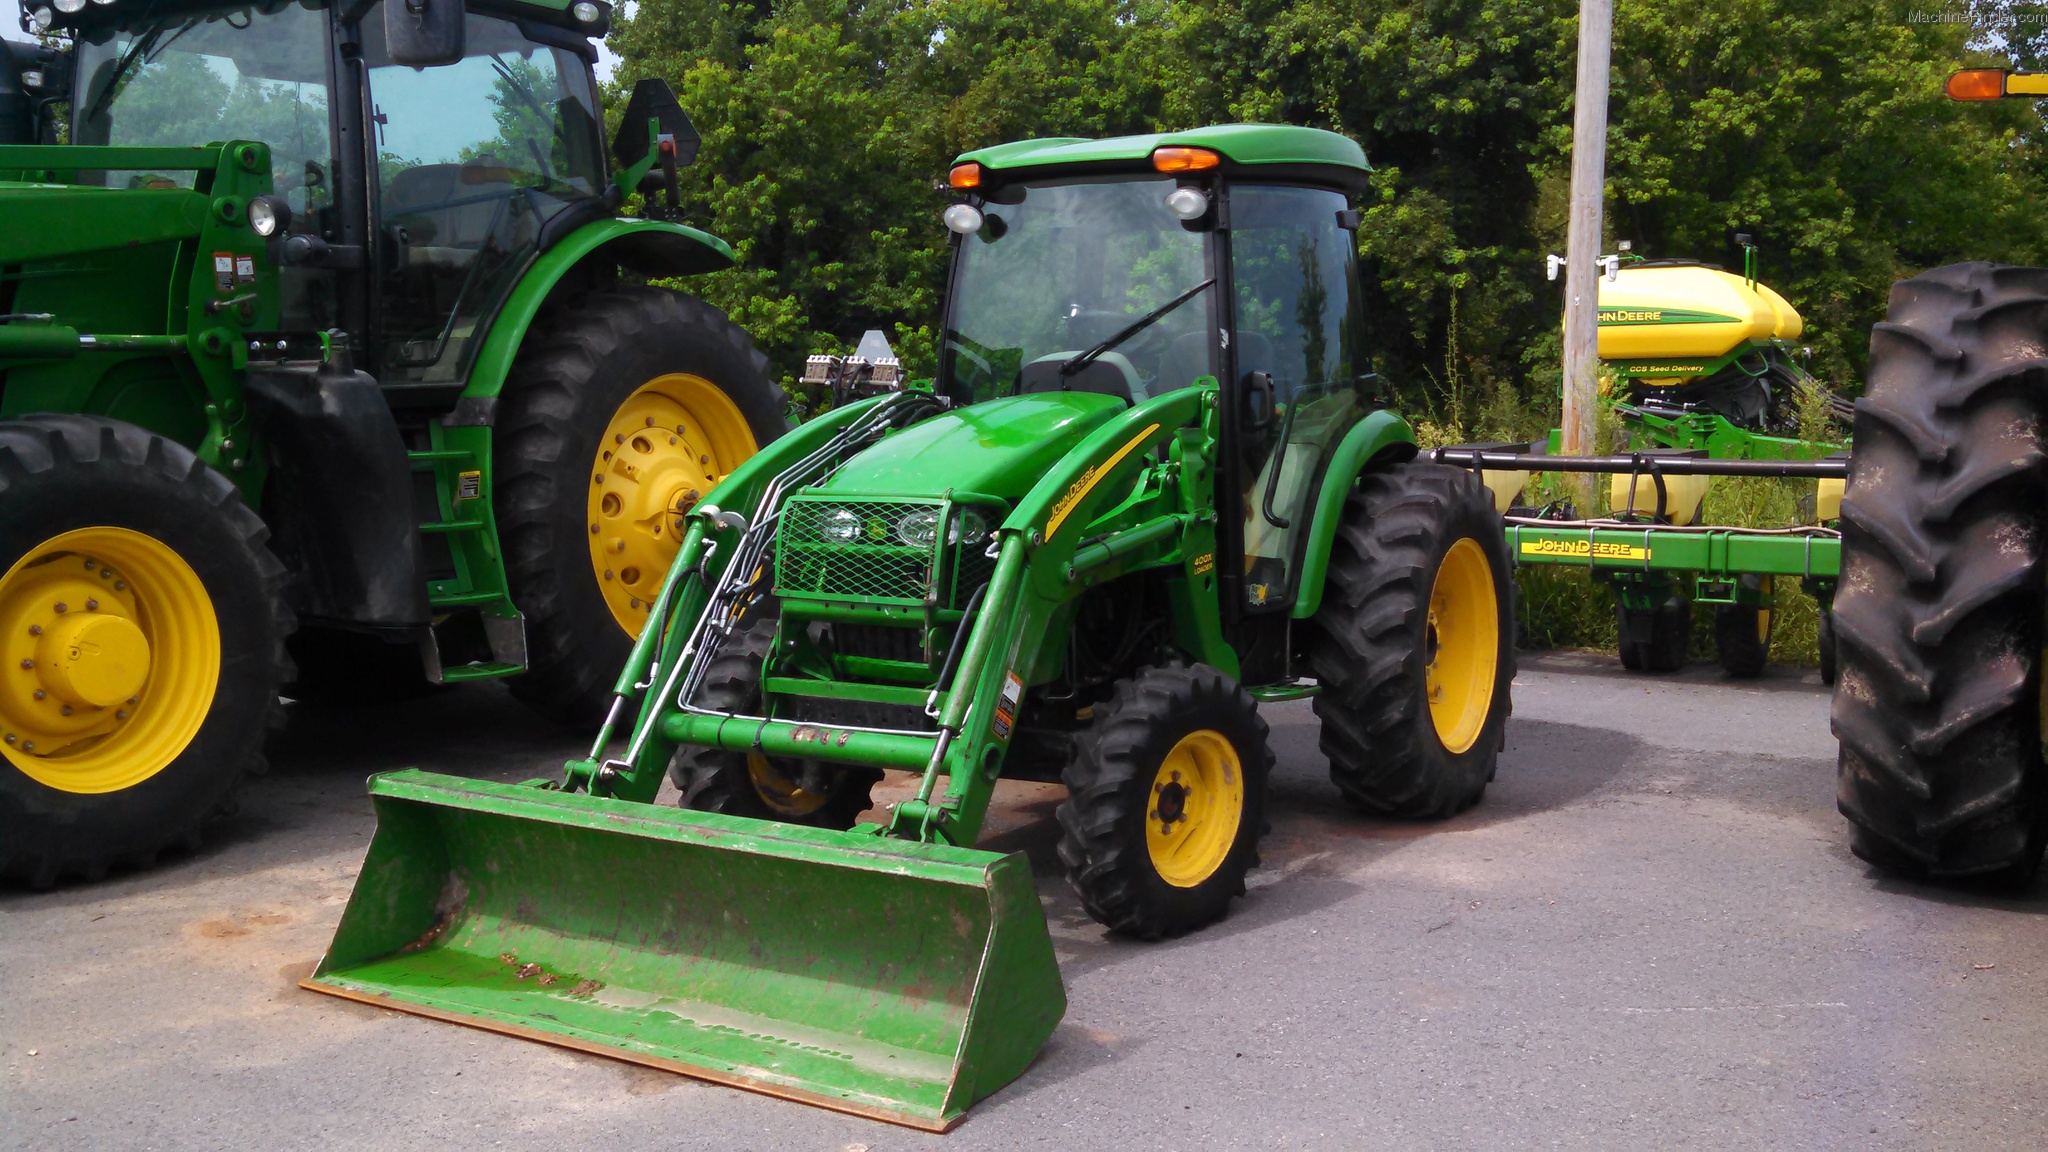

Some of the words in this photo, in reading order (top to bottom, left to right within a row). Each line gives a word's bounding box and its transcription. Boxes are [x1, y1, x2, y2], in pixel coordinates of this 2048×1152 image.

[1597, 312, 1616, 322] HN
[1617, 310, 1661, 321] DEERE
[1671, 365, 1704, 373] Delivery
[1050, 492, 1070, 522] JOHN
[1070, 465, 1096, 499] DEERE
[1534, 538, 1576, 552] JOHN
[1578, 540, 1631, 555] DEERE
[1194, 553, 1212, 566] 400X
[1193, 563, 1213, 576] LOADER
